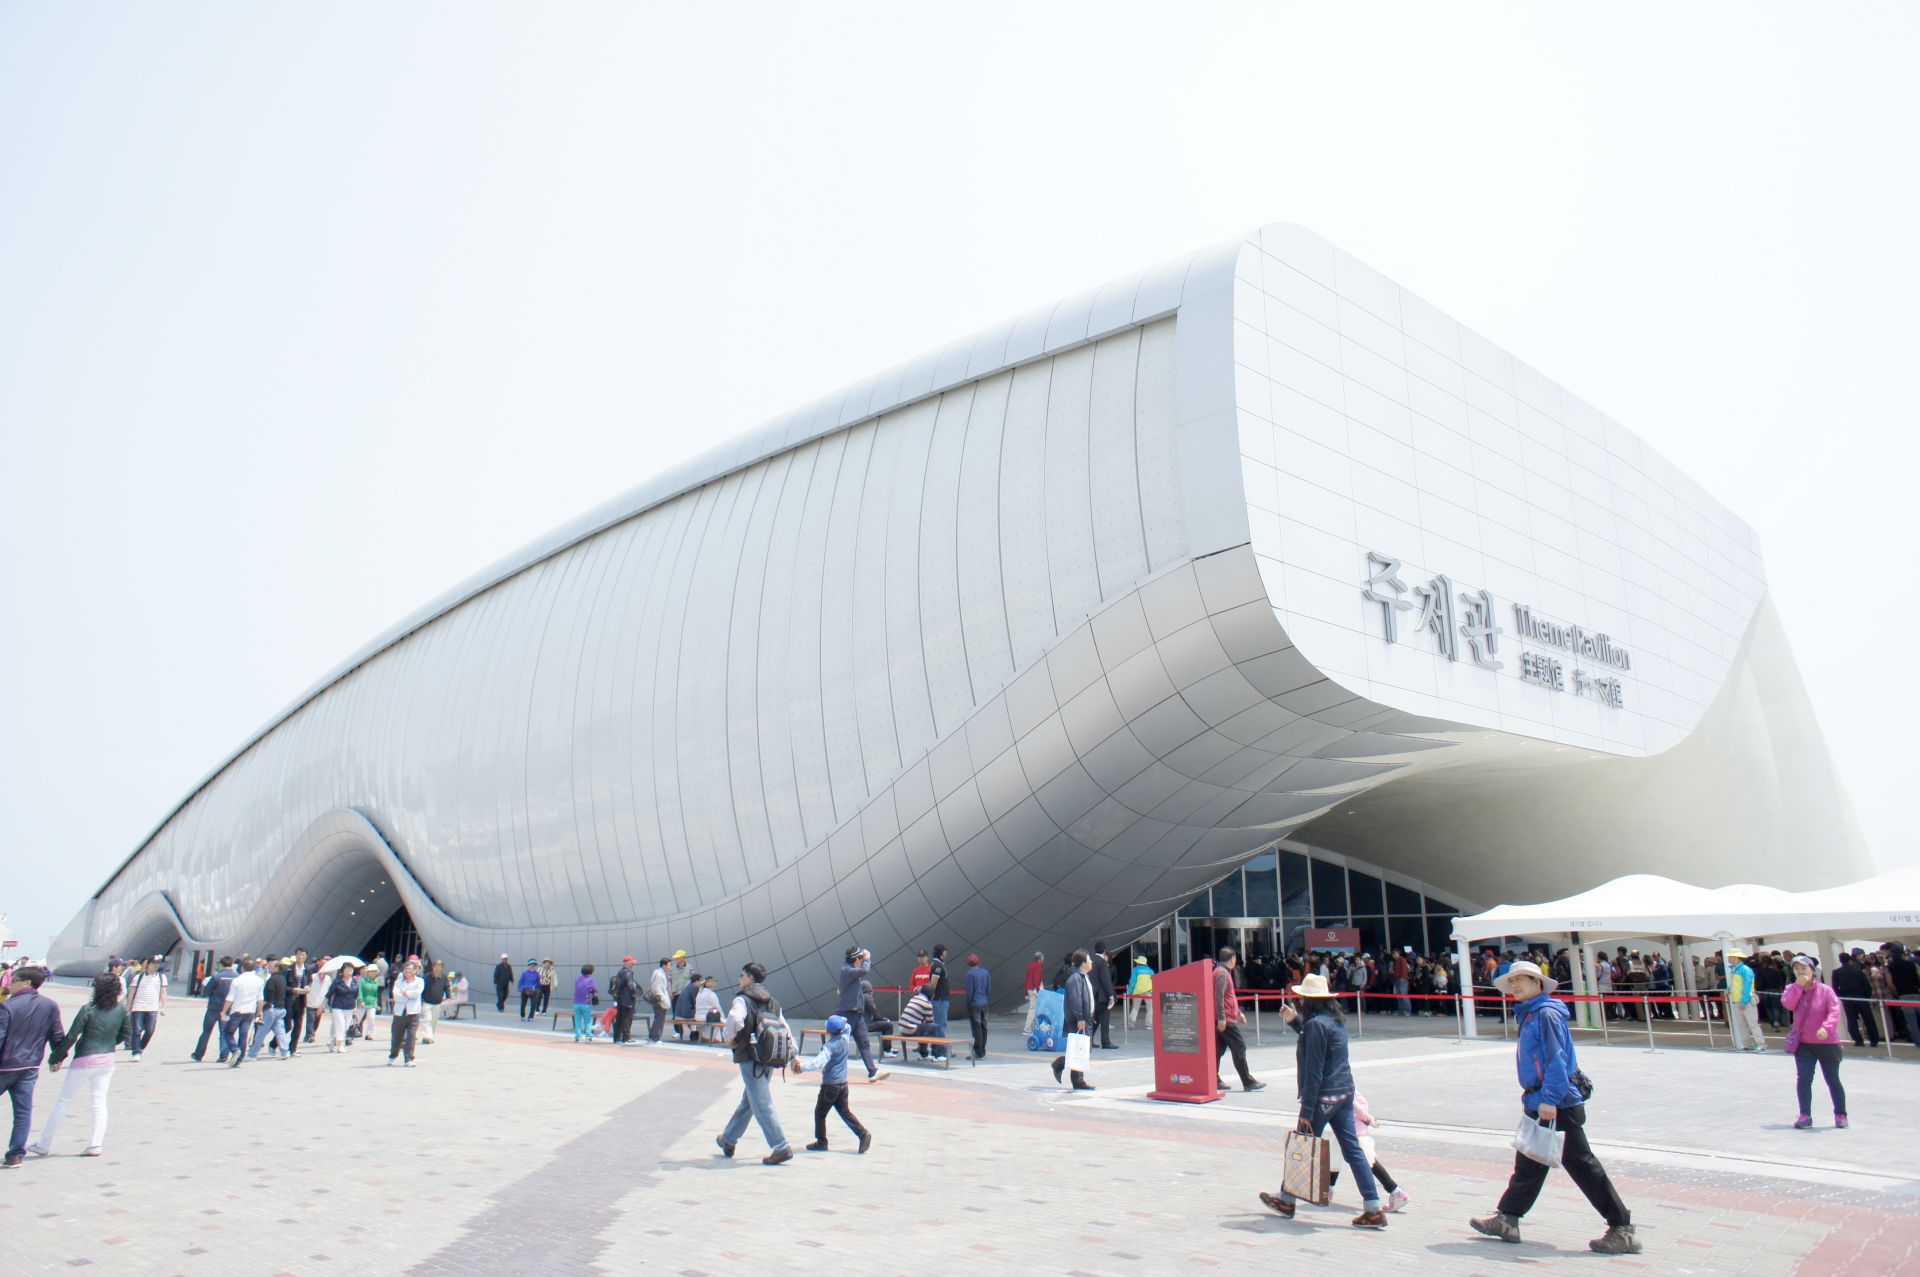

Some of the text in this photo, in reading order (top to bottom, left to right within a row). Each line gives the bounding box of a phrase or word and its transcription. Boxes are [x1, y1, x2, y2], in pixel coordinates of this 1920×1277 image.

[1361, 551, 1504, 671] 주제관
[1513, 602, 1631, 671] Theme Pavilion
